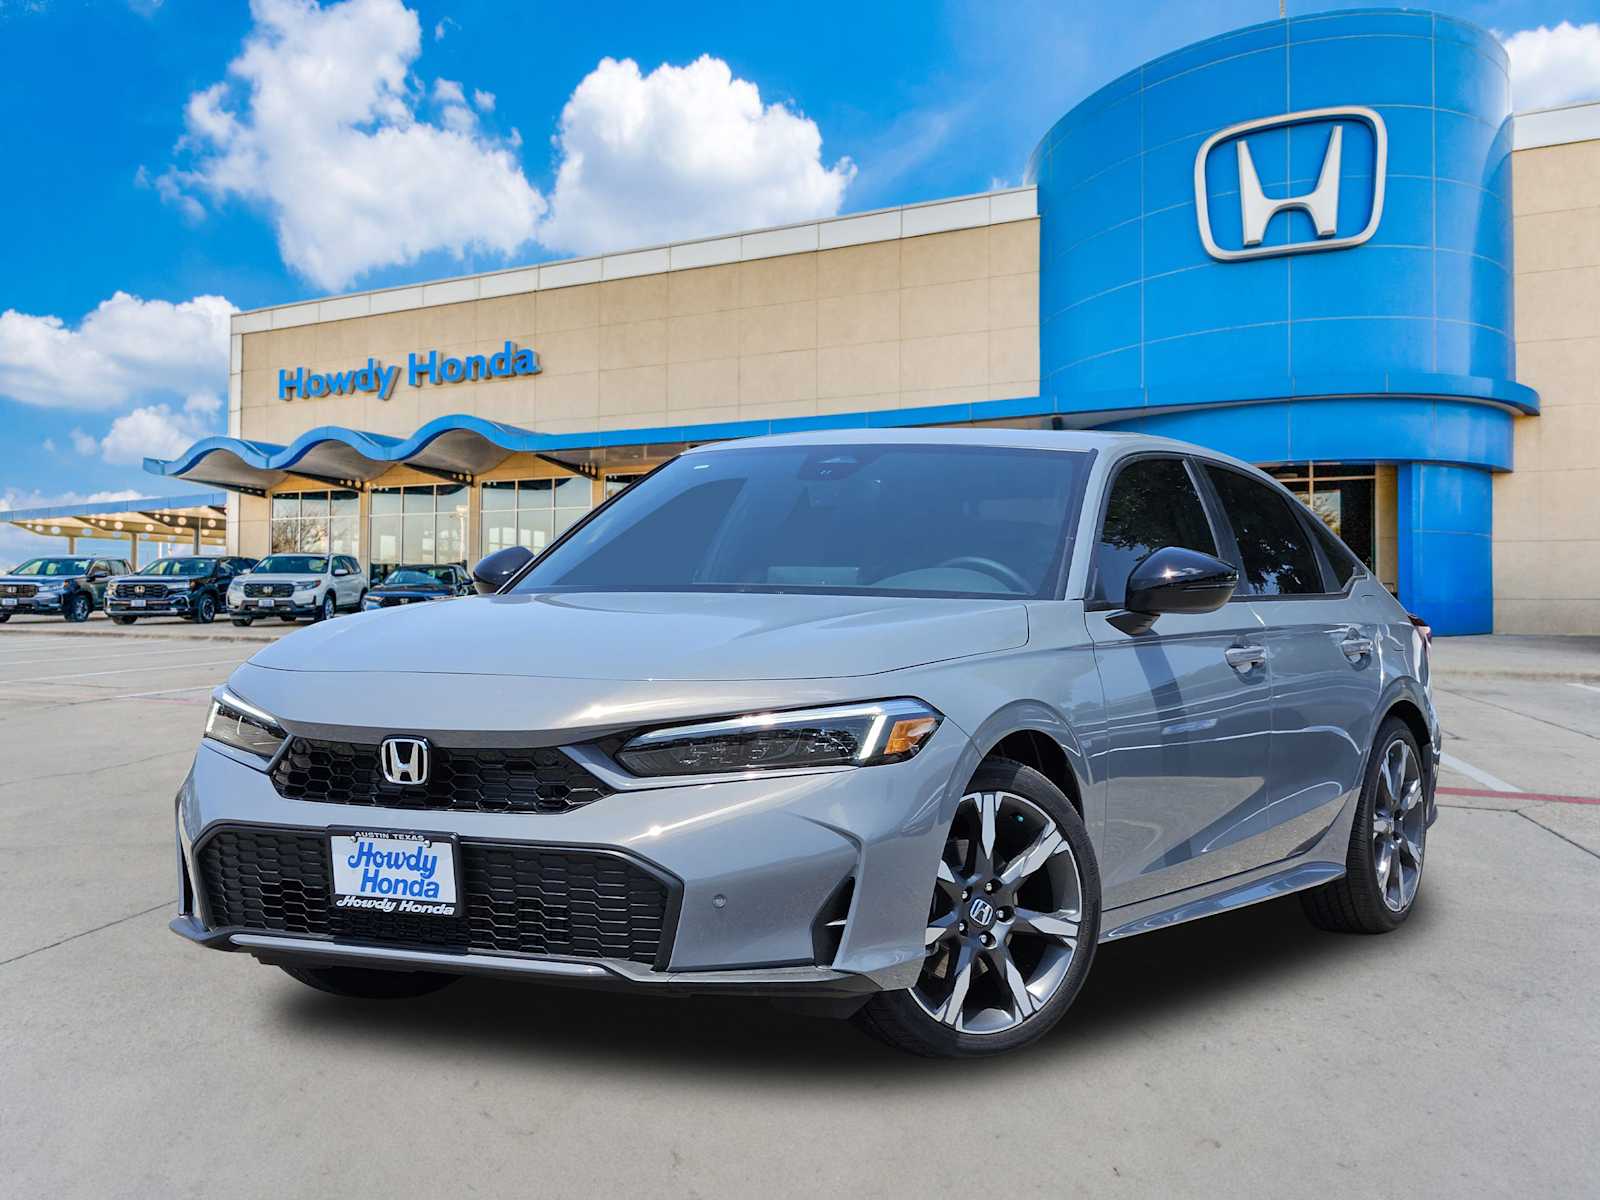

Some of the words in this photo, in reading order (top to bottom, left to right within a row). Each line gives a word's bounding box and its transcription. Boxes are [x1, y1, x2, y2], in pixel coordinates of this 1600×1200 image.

[279, 357, 400, 400] Howdy
[408, 341, 541, 387] Honda
[355, 831, 390, 840] AUSTIN
[392, 833, 425, 842] TEXAS
[348, 841, 438, 879] Howdy
[360, 868, 440, 899] Honda
[336, 895, 397, 913] Howdy
[399, 900, 455, 916] Honda
